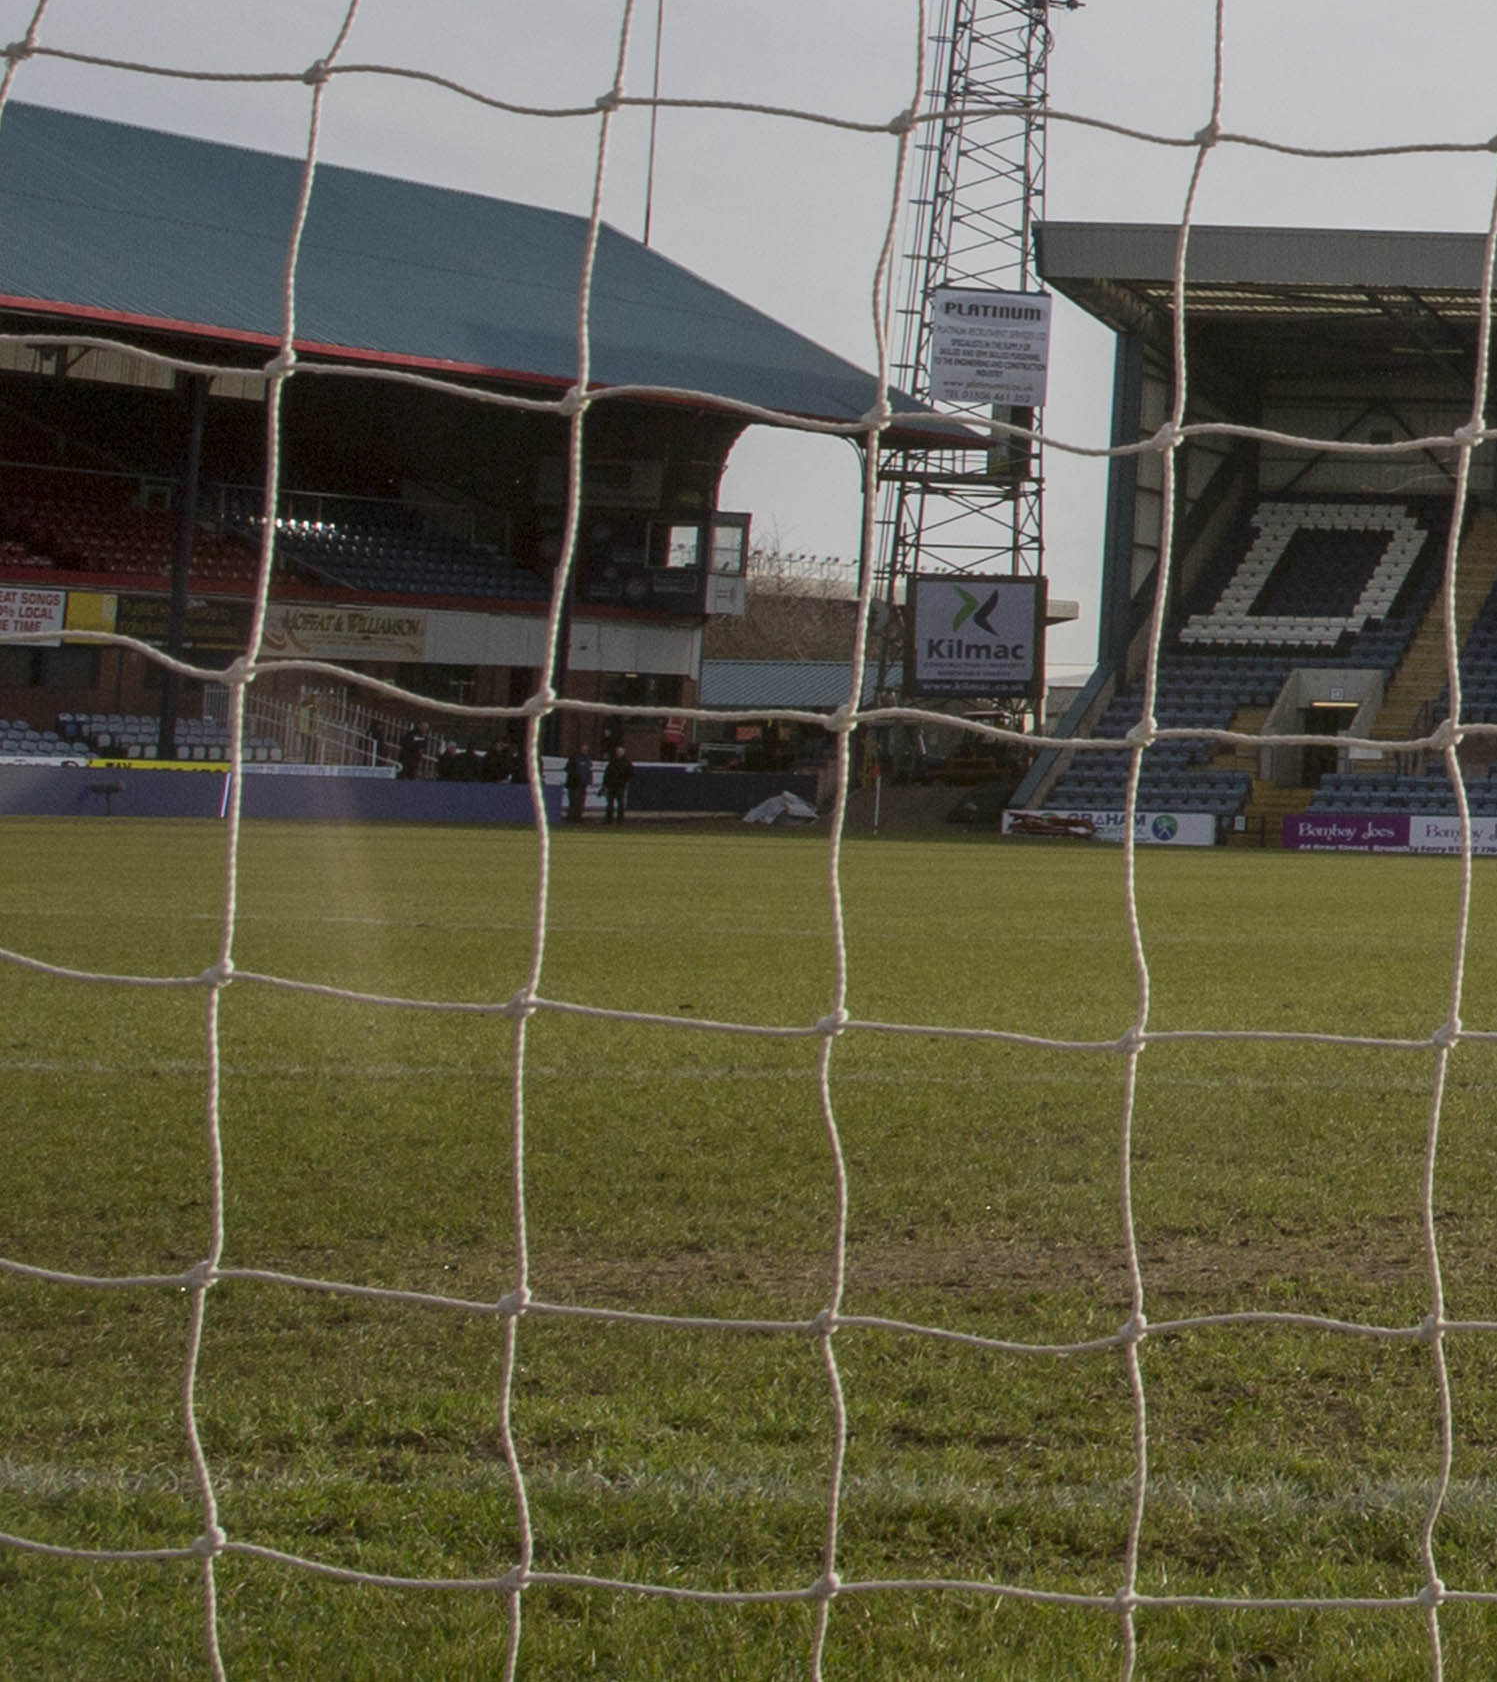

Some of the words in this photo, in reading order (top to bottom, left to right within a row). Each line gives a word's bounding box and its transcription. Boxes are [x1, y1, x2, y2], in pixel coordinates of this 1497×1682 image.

[22, 592, 61, 606] SONGS
[18, 607, 54, 620] LOCAL
[14, 619, 42, 631] TIME
[927, 638, 1025, 660] Kilmac
[1298, 822, 1357, 842] Bombay
[1361, 821, 1395, 840] Joes
